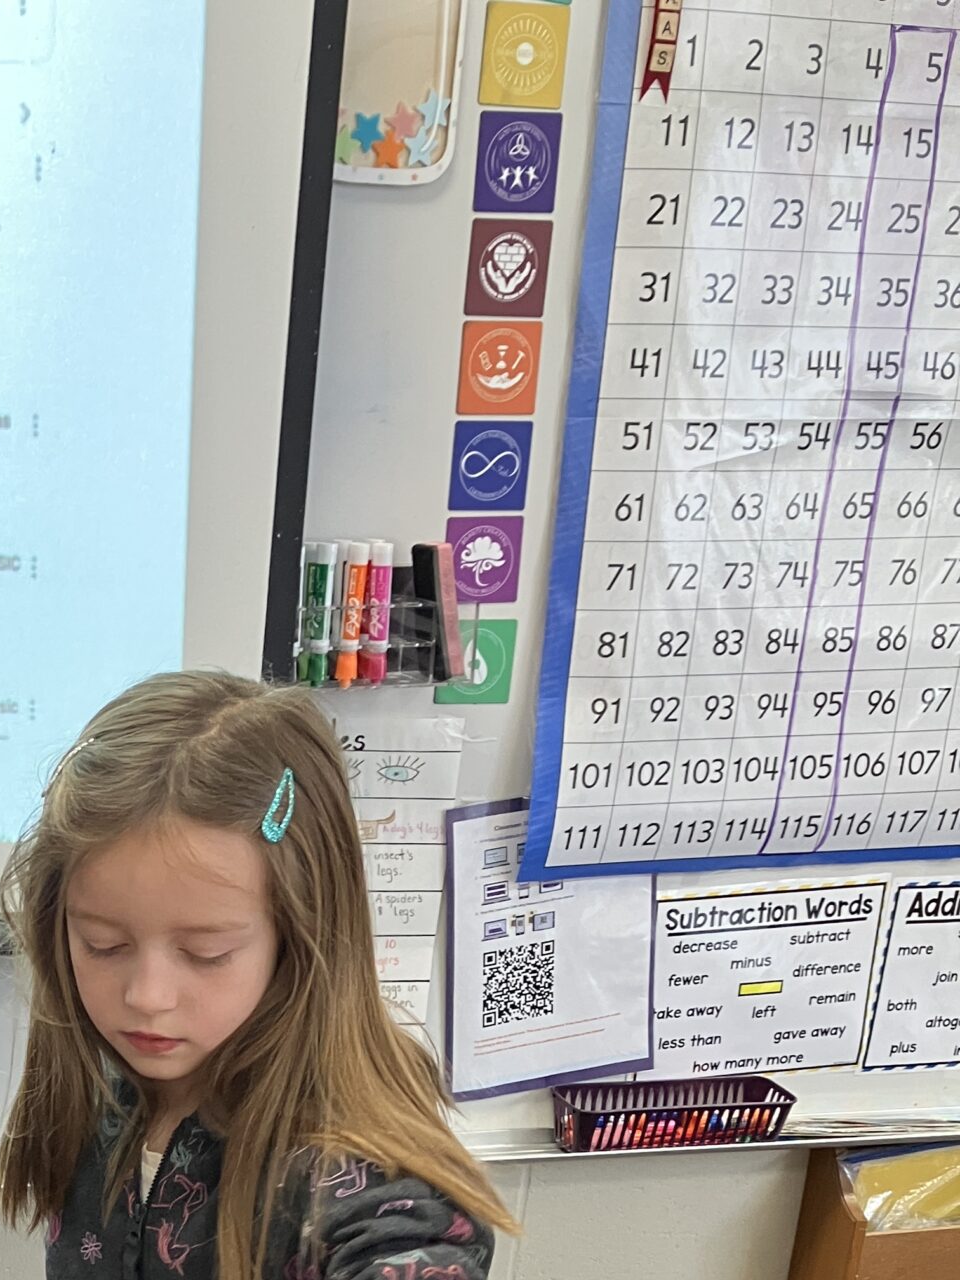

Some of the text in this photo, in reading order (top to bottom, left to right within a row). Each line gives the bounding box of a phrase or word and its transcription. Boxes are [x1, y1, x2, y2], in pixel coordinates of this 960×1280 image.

[687, 34, 943, 83] 1 2 3 4 5
[661, 115, 933, 159] 11 12 13 14 15
[646, 194, 922, 234] 21 22 23 24 25
[639, 271, 910, 307] 31 32 33 34 35
[630, 347, 956, 380] 41 42 43 44 45 46
[622, 421, 943, 451] 51 52 53 54 55 56
[597, 623, 960, 658] 81 82 83 84 85 86 87
[590, 687, 952, 725] 91 92 93 94 95 96 97
[568, 750, 941, 789] 101 102 103 104 105 106 107
[564, 810, 927, 851] 111 112 113 114 115 116 117
[394, 906, 416, 925] legs
[665, 893, 873, 931] Subtraction Words
[673, 928, 851, 955] decrease subtract
[897, 944, 934, 957] more
[668, 961, 862, 988] fewer difference
[730, 955, 772, 970] minus
[932, 971, 958, 987] join
[686, 1004, 724, 1022] away
[751, 1005, 777, 1019] left
[808, 991, 856, 1006] remain
[887, 1000, 918, 1013] both
[657, 1024, 847, 1051] less than gave away
[889, 1041, 917, 1058] plus
[692, 1052, 804, 1073] how many more
